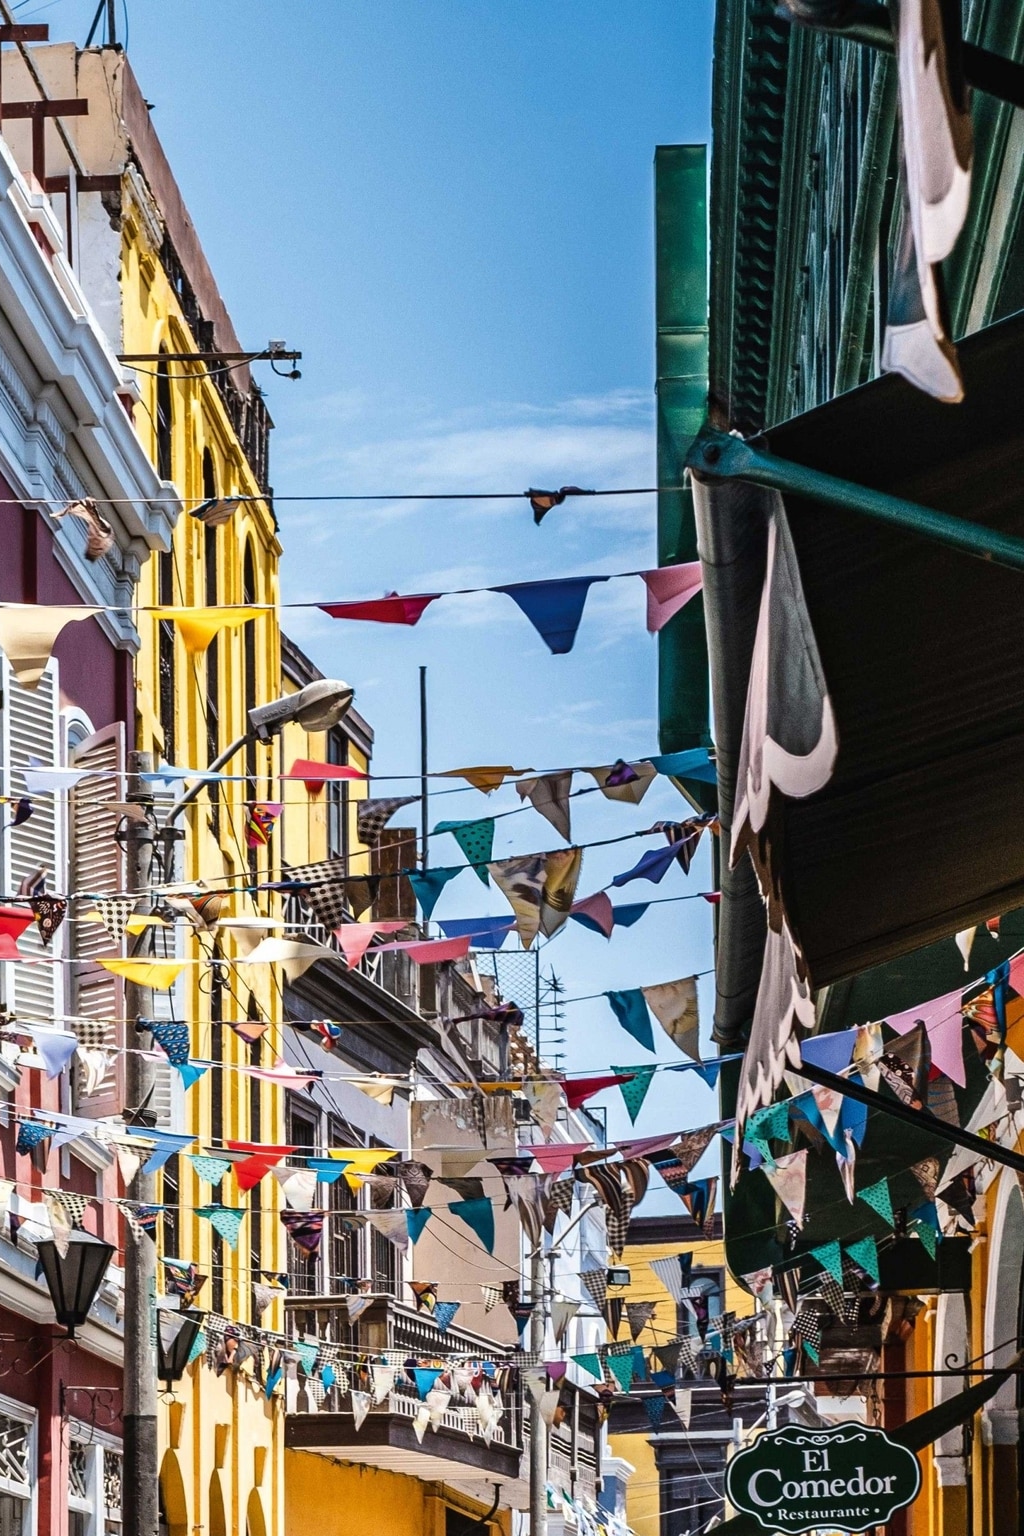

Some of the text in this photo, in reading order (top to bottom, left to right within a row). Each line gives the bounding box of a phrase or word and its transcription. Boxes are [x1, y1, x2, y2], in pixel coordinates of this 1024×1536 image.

[802, 1449, 831, 1473] El
[747, 1466, 897, 1507] Comedor
[777, 1507, 870, 1521] Restaurante
